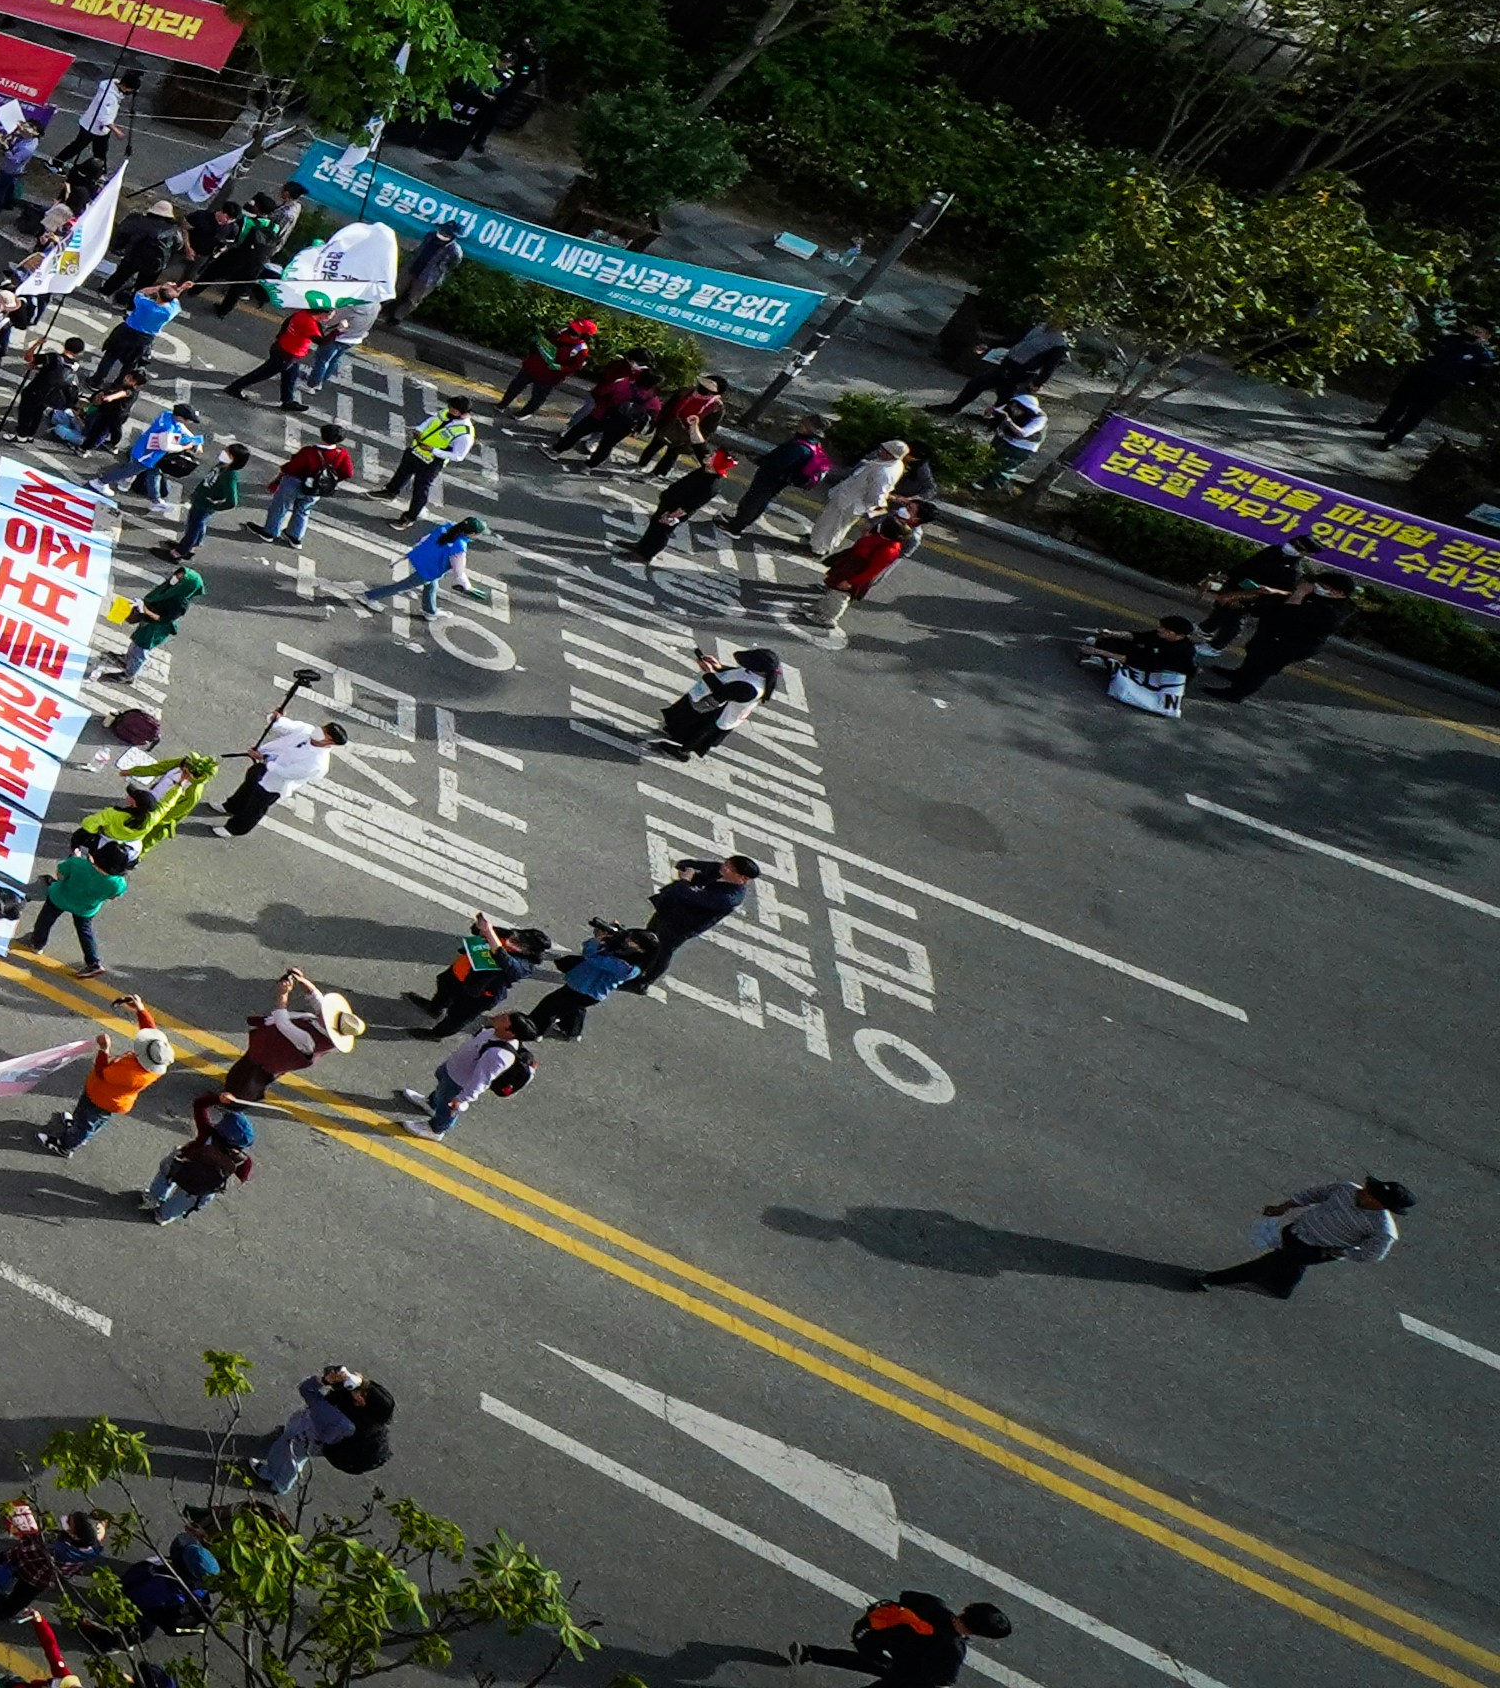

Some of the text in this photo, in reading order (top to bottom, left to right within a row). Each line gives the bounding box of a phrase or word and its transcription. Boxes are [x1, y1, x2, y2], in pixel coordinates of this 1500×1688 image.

[314, 154, 790, 329] 전북은 항공오지가 아니다. 새만금신공항 필요없다.
[1100, 450, 1197, 500] 보호할
[1200, 485, 1301, 535] 책무가
[1309, 521, 1381, 564] 있다.
[1119, 429, 1213, 479] 정부는
[1219, 464, 1324, 513] 갯벌을
[1320, 500, 1441, 548] 파괴할
